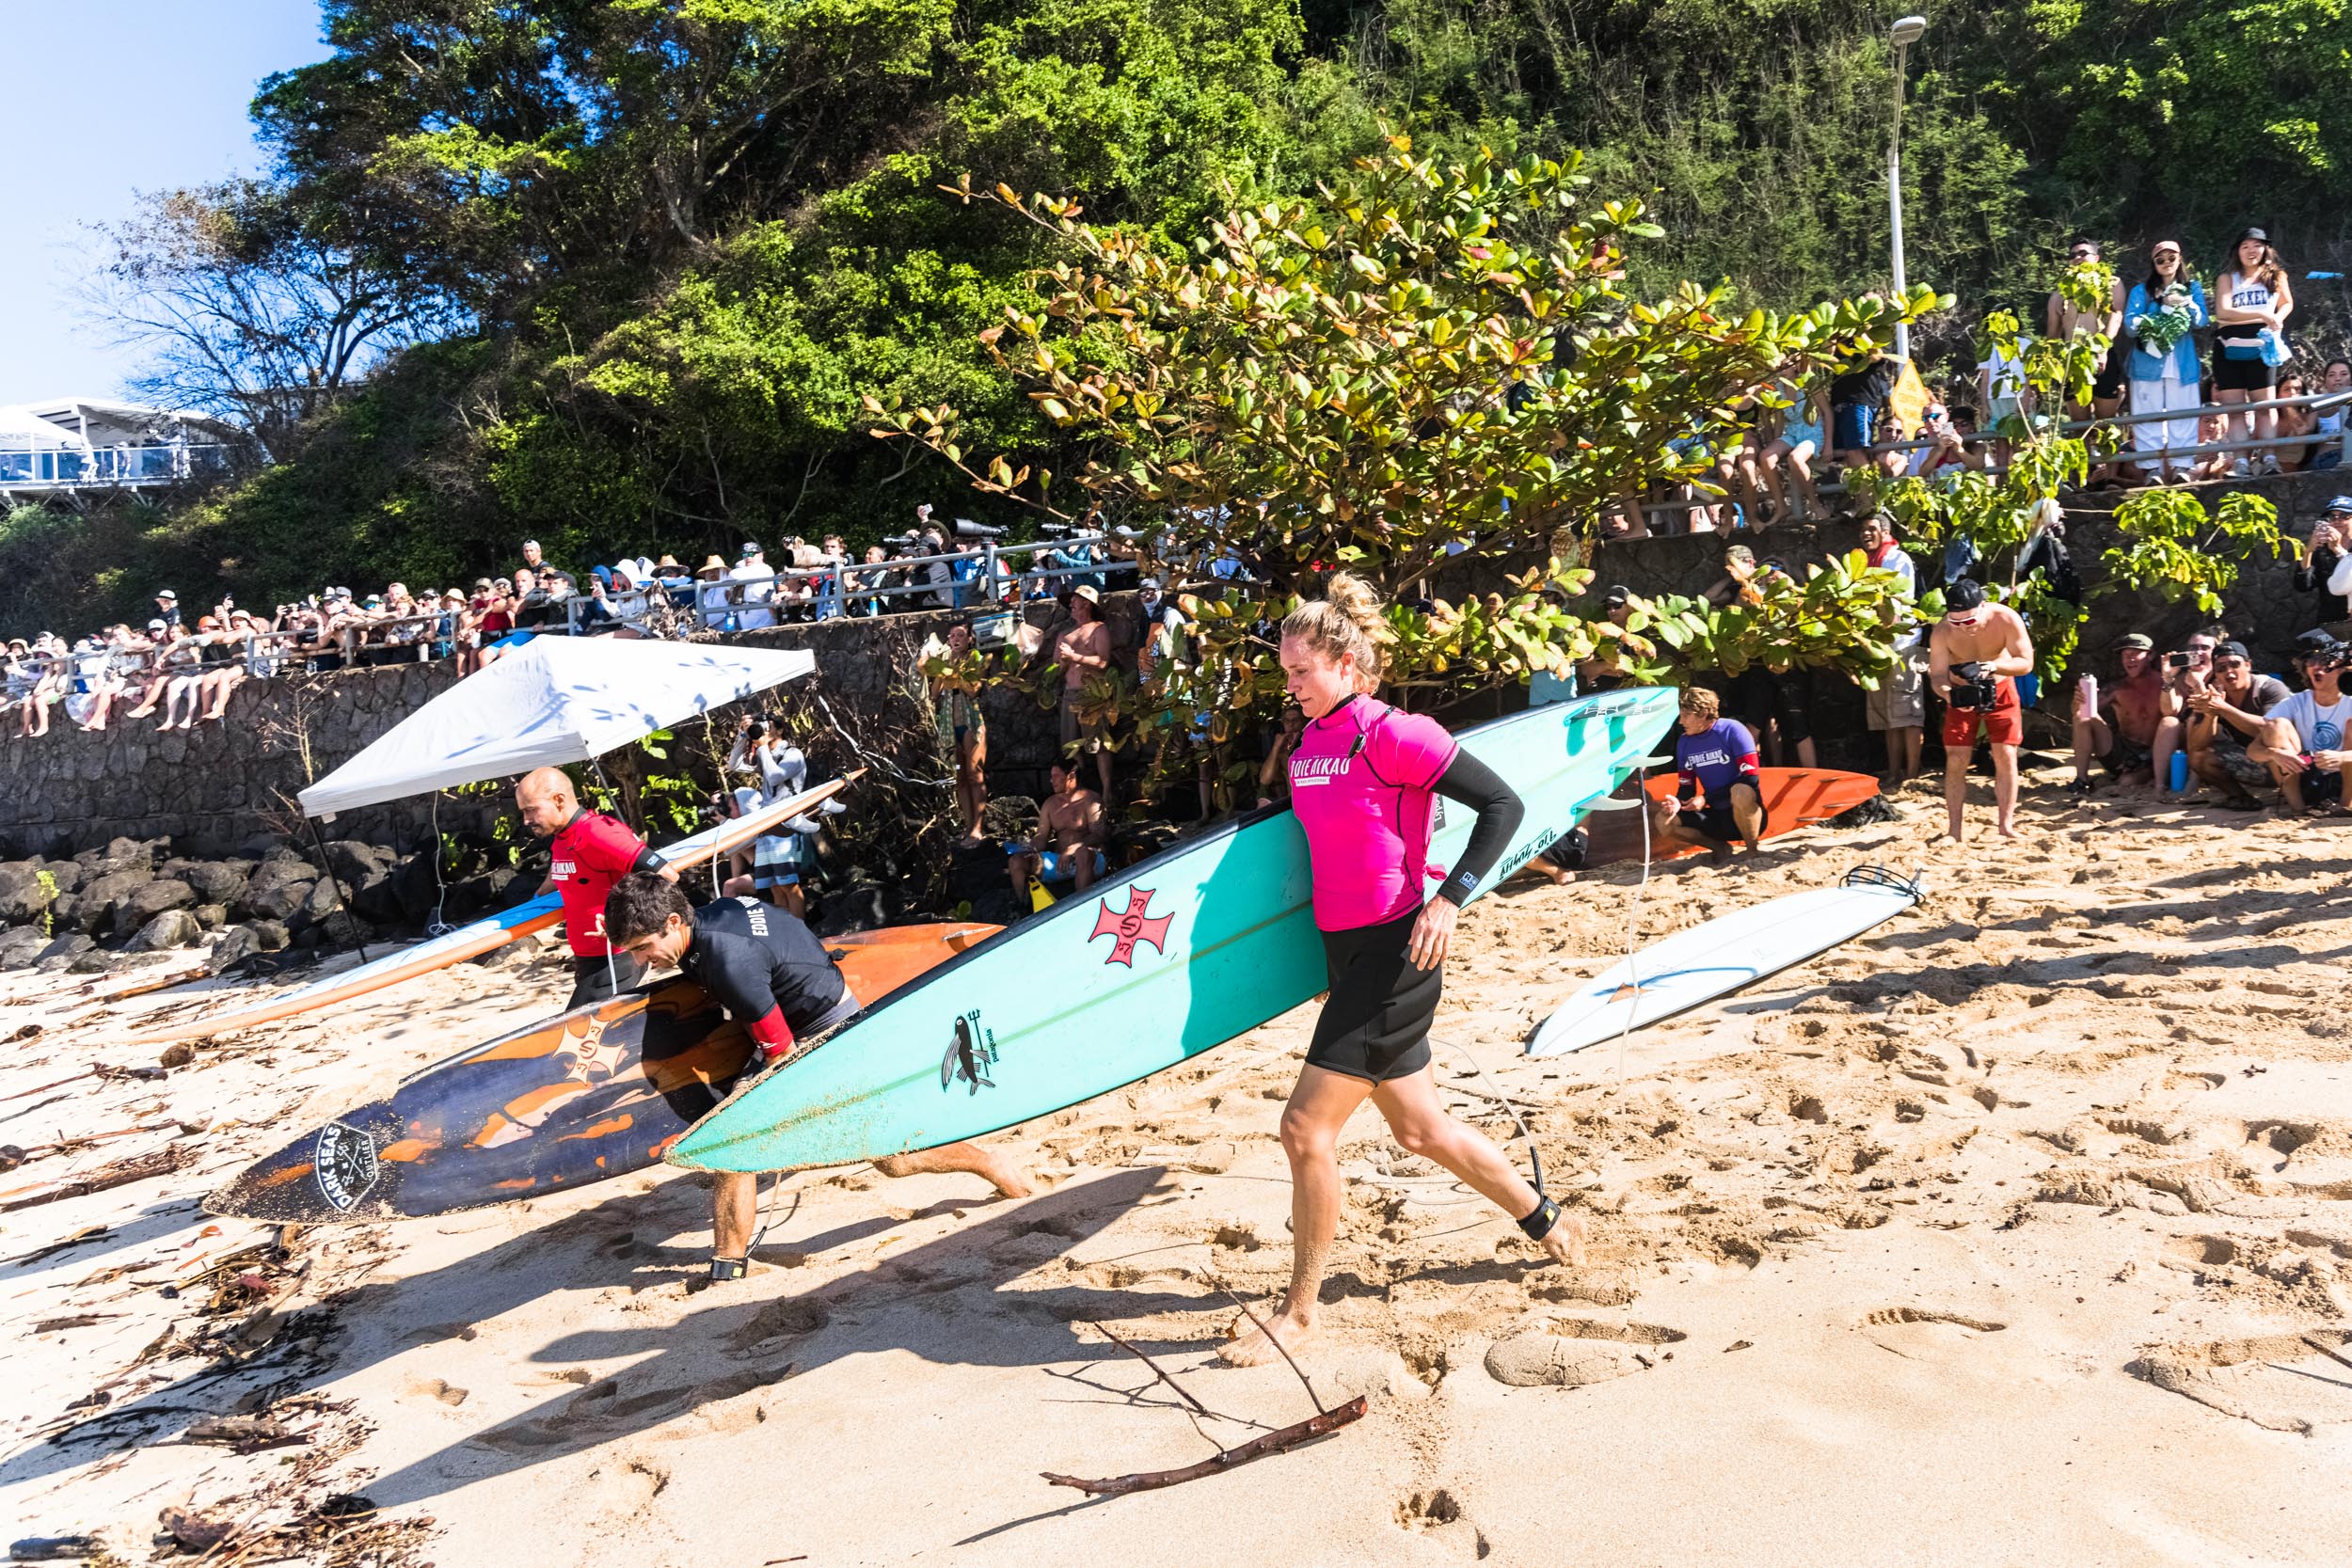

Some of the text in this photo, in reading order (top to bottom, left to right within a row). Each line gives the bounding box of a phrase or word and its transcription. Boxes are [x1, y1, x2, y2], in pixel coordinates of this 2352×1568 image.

[2232, 291, 2267, 308] ERKEL
[1310, 757, 1350, 776] AIKAU
[746, 908, 769, 936] EDDIE
[986, 1028, 999, 1063] patagonia
[320, 1127, 353, 1208] DARK SEAS
[360, 1139, 374, 1178] OUTLIER
